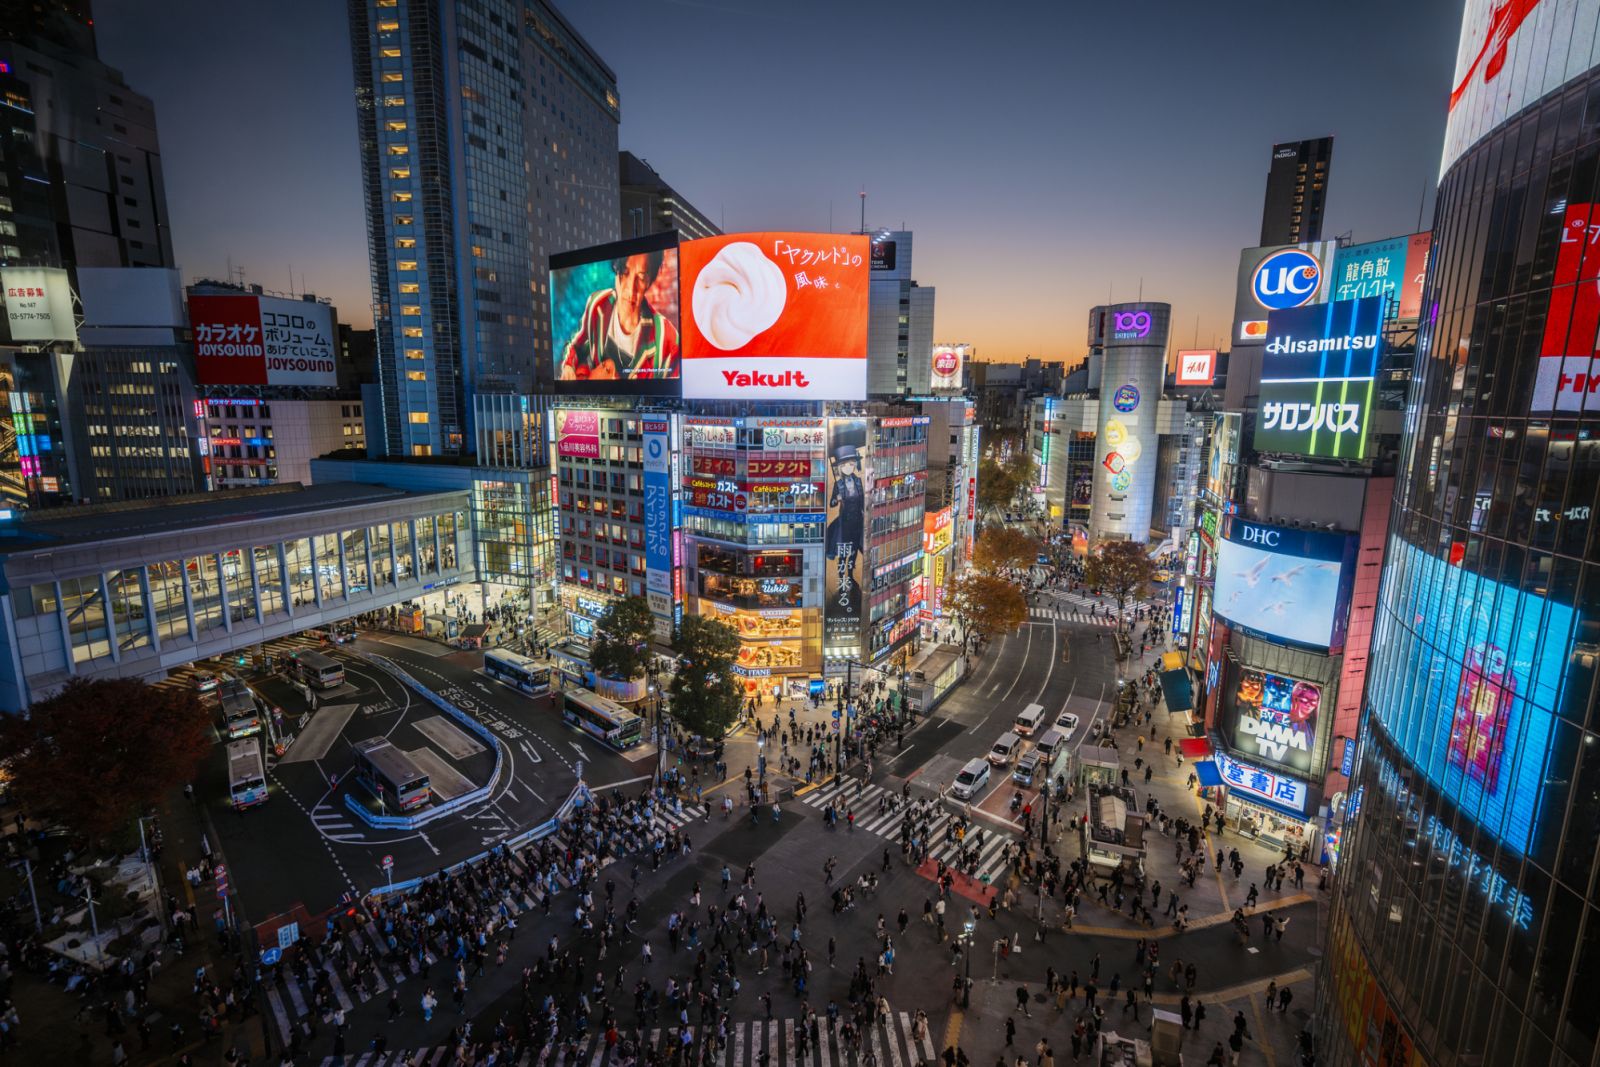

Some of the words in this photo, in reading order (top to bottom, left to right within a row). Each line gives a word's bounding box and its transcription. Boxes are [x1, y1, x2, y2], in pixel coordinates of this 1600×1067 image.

[1274, 151, 1296, 159] INDIGO
[1345, 256, 1390, 283] 龍角散
[1260, 265, 1315, 296] UC
[8, 287, 45, 298] 広告募集
[263, 312, 316, 329] ココロの
[1114, 312, 1151, 338] 109
[196, 322, 259, 343] カラオケ
[198, 343, 262, 357] JOYSOUND
[1266, 335, 1377, 355] Hisamitsu
[267, 357, 334, 373] JOYSOUND
[1187, 361, 1206, 374] H&M
[722, 370, 810, 388] Yakult
[1263, 402, 1359, 434] サロンパス
[707, 430, 734, 443] しゃぶ葉
[785, 431, 823, 445] しゃぶ葉
[564, 443, 597, 454] 品川美容外科
[748, 463, 809, 474] コンタクト
[717, 481, 738, 492] ガスト
[790, 483, 818, 494] ガスト
[707, 493, 732, 508] ガスト
[1243, 526, 1280, 546] DHC
[836, 541, 853, 612] 雨が来る。
[1239, 714, 1307, 752] DMM
[1255, 736, 1289, 761] TV
[1217, 752, 1297, 802] 堂書店
